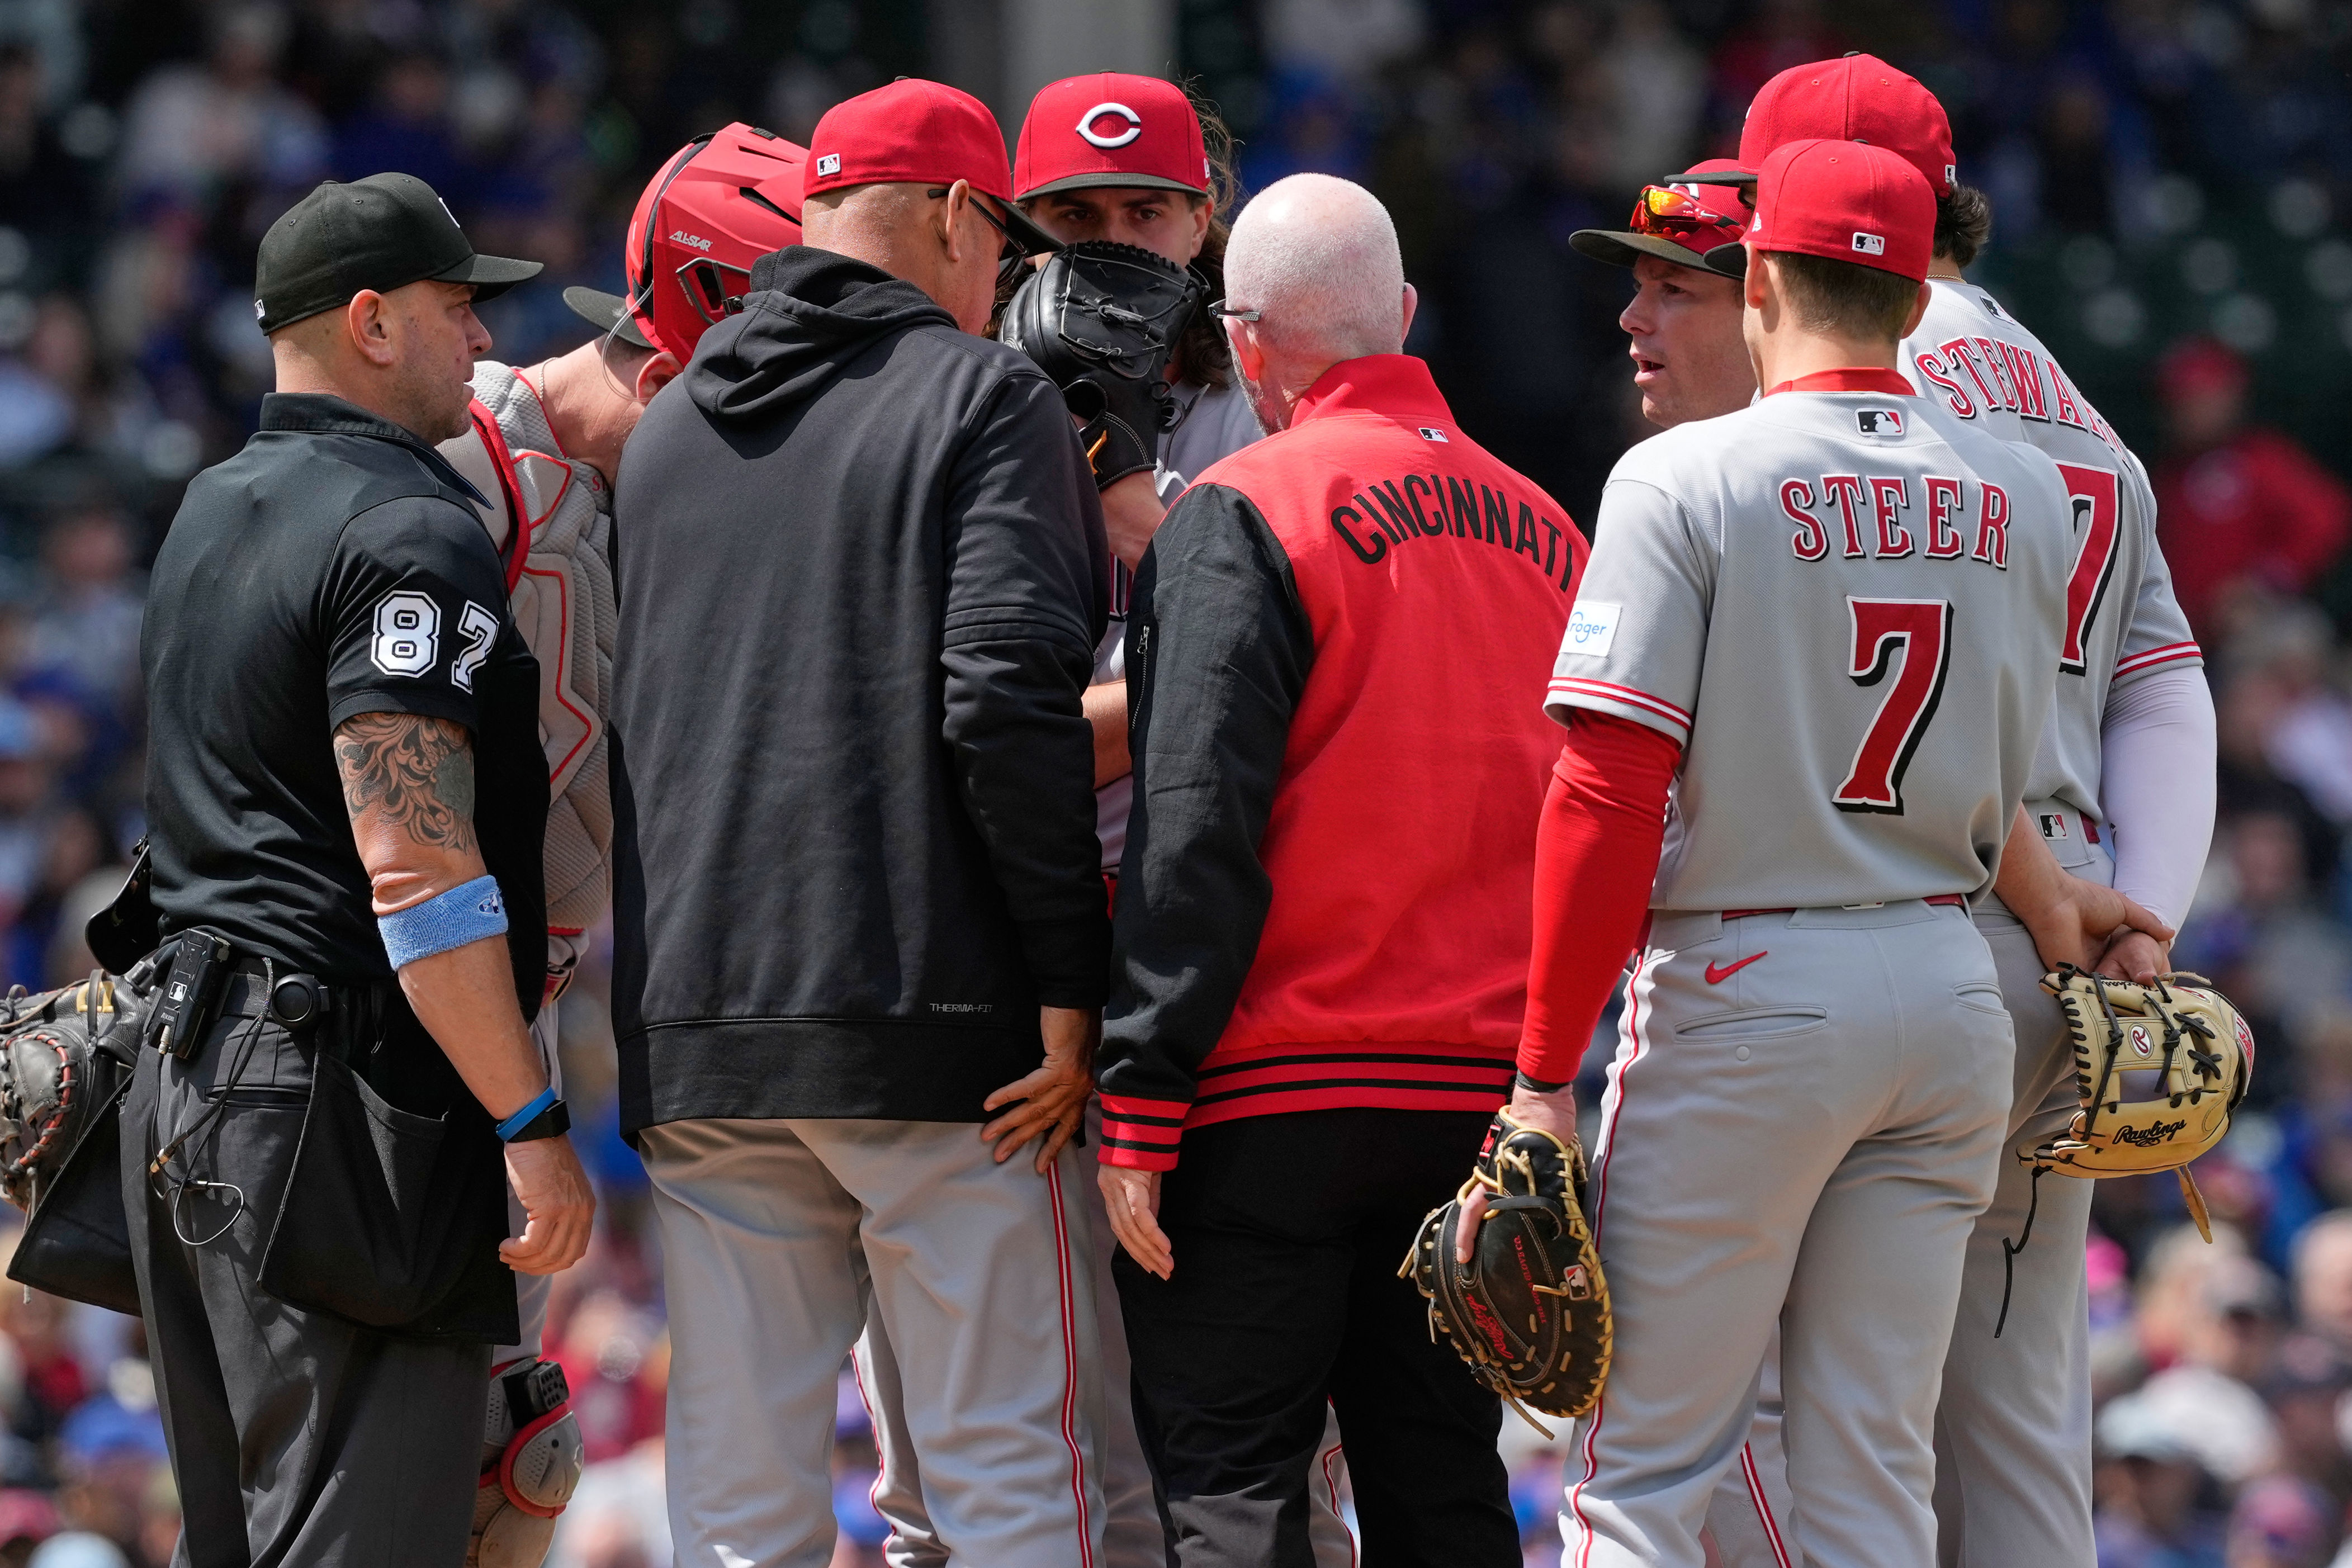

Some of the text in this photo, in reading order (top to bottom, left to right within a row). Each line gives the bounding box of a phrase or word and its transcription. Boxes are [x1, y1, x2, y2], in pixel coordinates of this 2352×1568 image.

[1076, 102, 1142, 150] C
[1331, 474, 1572, 593] CINCINNATI
[1778, 473, 2010, 571] STEER
[370, 590, 500, 695] 87
[1567, 611, 1607, 643] roger
[1832, 595, 1953, 816] 7
[929, 1003, 993, 1013] THERMA-FIT
[2112, 1119, 2188, 1146] Rawlings
[1465, 1293, 1514, 1359] Rawlings
